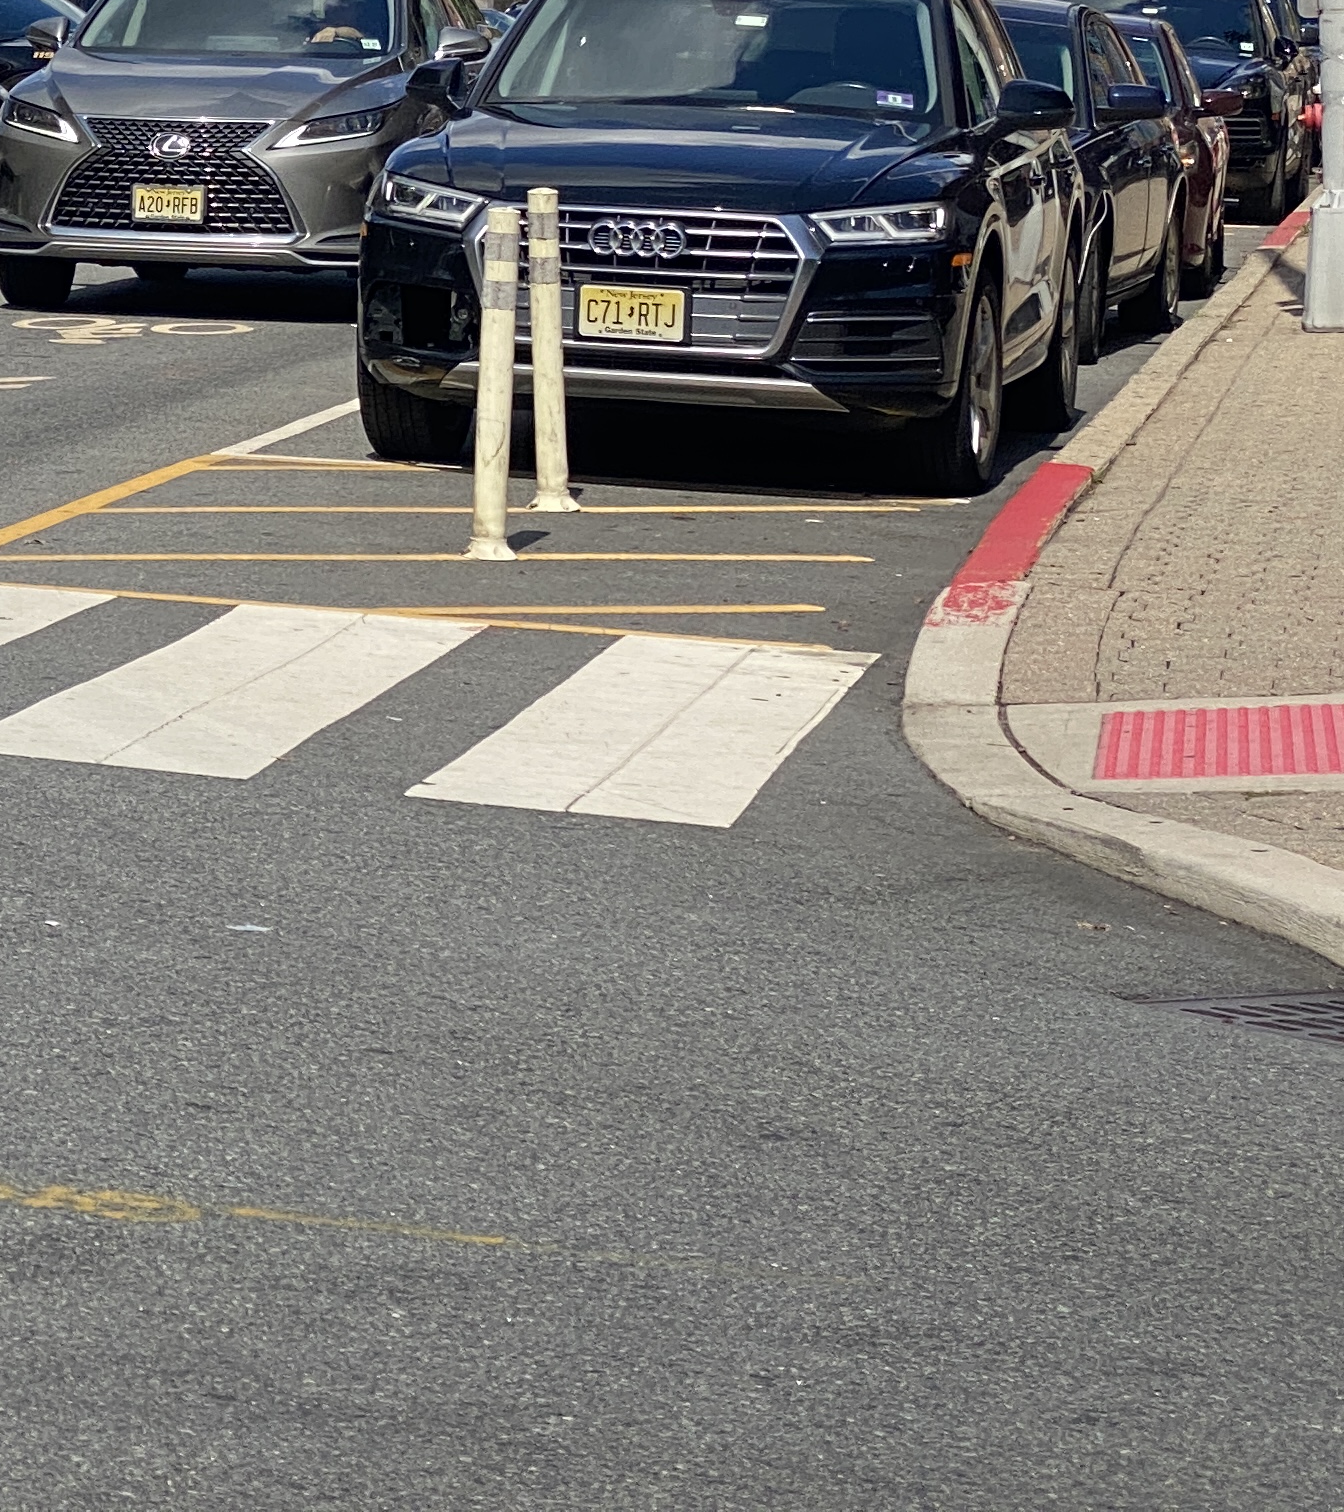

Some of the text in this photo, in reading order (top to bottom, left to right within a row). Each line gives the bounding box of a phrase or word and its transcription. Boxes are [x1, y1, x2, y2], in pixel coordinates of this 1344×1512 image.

[606, 289, 658, 301] New Jersey
[604, 326, 657, 336] Garden State
